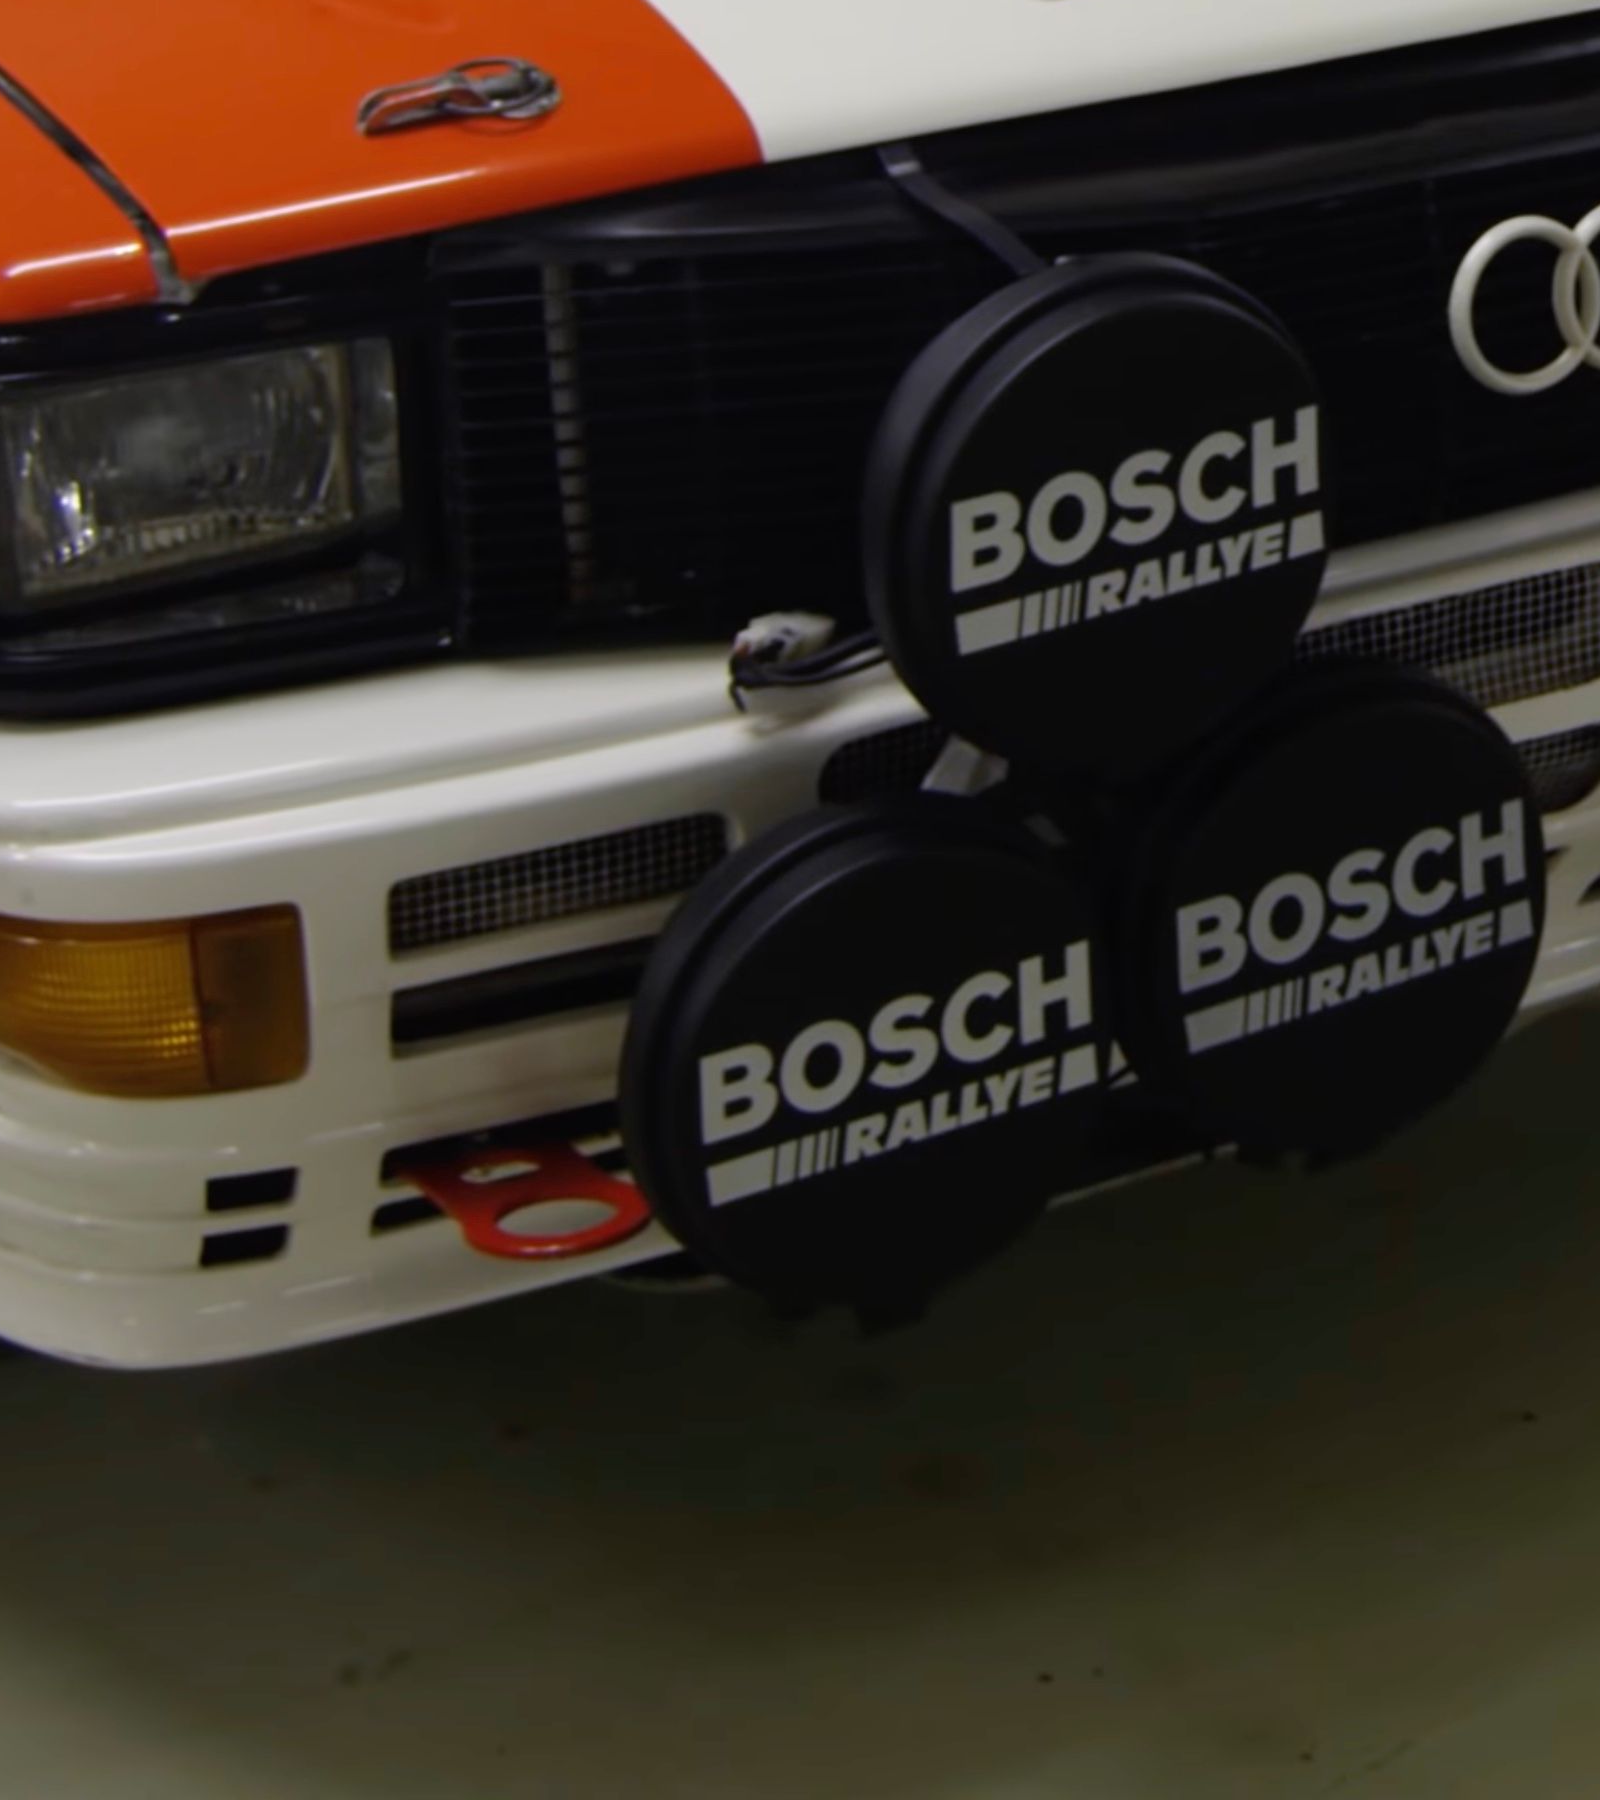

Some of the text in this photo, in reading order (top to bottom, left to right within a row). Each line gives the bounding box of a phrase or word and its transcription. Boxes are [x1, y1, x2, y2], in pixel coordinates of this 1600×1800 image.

[949, 404, 1321, 594] BOSCH
[1084, 521, 1286, 618] RALLYE
[1175, 797, 1528, 995] BOSCH
[1305, 917, 1495, 1014] RALLYE
[697, 939, 1092, 1145] BOSCH
[842, 1055, 1056, 1165] RALLYE
